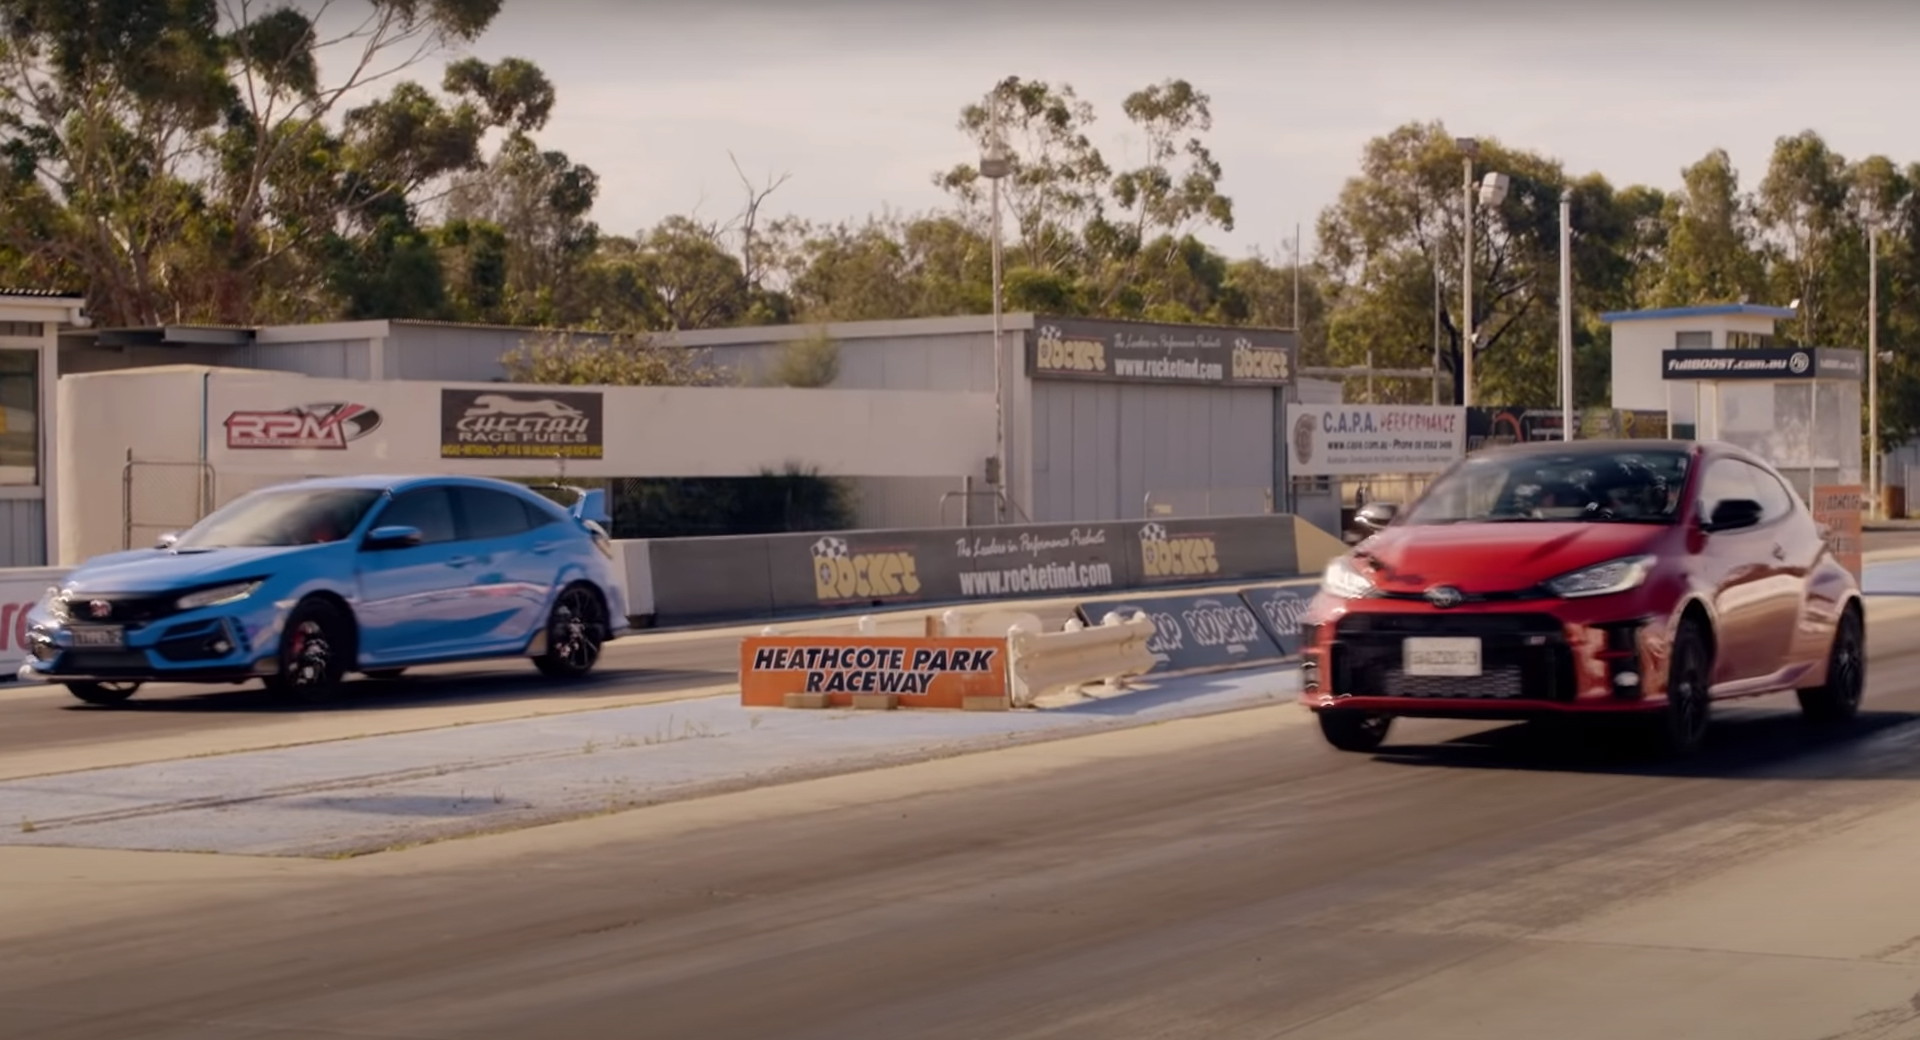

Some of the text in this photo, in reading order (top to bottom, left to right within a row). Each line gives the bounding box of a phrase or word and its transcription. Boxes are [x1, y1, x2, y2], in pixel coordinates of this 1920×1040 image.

[1114, 357, 1223, 379] www.rocketind.com
[231, 414, 343, 444] RPM
[456, 416, 590, 433] CHEETAH
[1323, 411, 1377, 433] C.A.P.A.
[458, 432, 588, 443] RACE FUELS
[955, 537, 971, 557] The
[1007, 540, 1018, 553] in
[1019, 532, 1070, 557] Performance
[959, 561, 1112, 595] www.rocketind.com
[753, 646, 998, 673] HEATHCOTE PARK
[804, 670, 937, 695] RACEWAY
